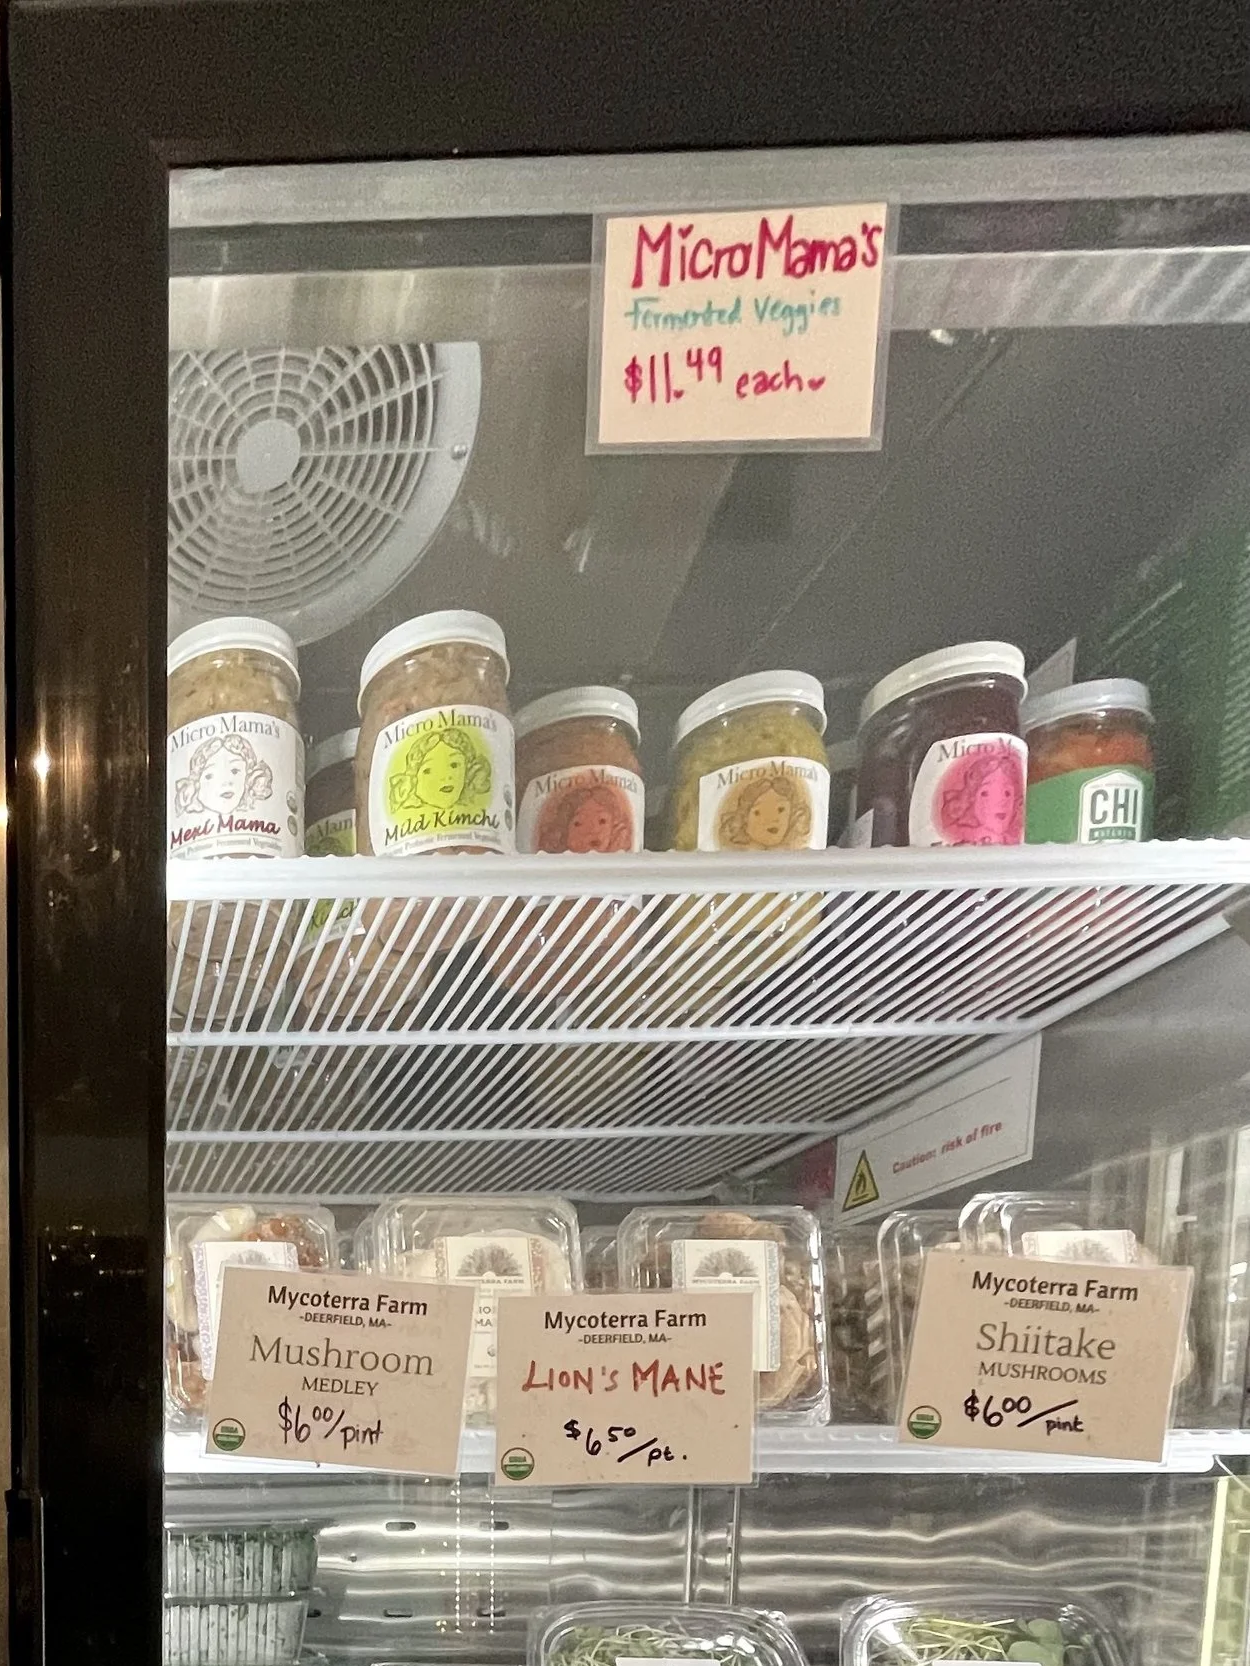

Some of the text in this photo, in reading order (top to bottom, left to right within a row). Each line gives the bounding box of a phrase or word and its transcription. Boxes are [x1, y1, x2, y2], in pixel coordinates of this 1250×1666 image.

[755, 290, 842, 337] Veggies
[736, 359, 802, 400] each
[171, 715, 281, 752] Micro Mama's
[384, 708, 498, 749] Micro Mama's
[936, 741, 994, 763] Micro
[534, 776, 583, 798] Micro
[717, 767, 766, 790] Micro
[1091, 788, 1138, 824] CHI
[170, 815, 281, 850] Mexi Mama
[384, 808, 500, 846] Mild Kimchi
[941, 1121, 1002, 1155] risk of fire
[268, 1285, 428, 1316] Mycoterra Farm
[972, 1270, 1138, 1302] Mycoterra Farm
[544, 1309, 707, 1334] Mycoterra Farm
[250, 1334, 434, 1376] Mushroom
[976, 1321, 1116, 1360] Shiitake
[302, 1376, 379, 1396] MEDLEY
[521, 1359, 726, 1398] LION'S MANE
[978, 1361, 1107, 1385] MUSHROOMS
